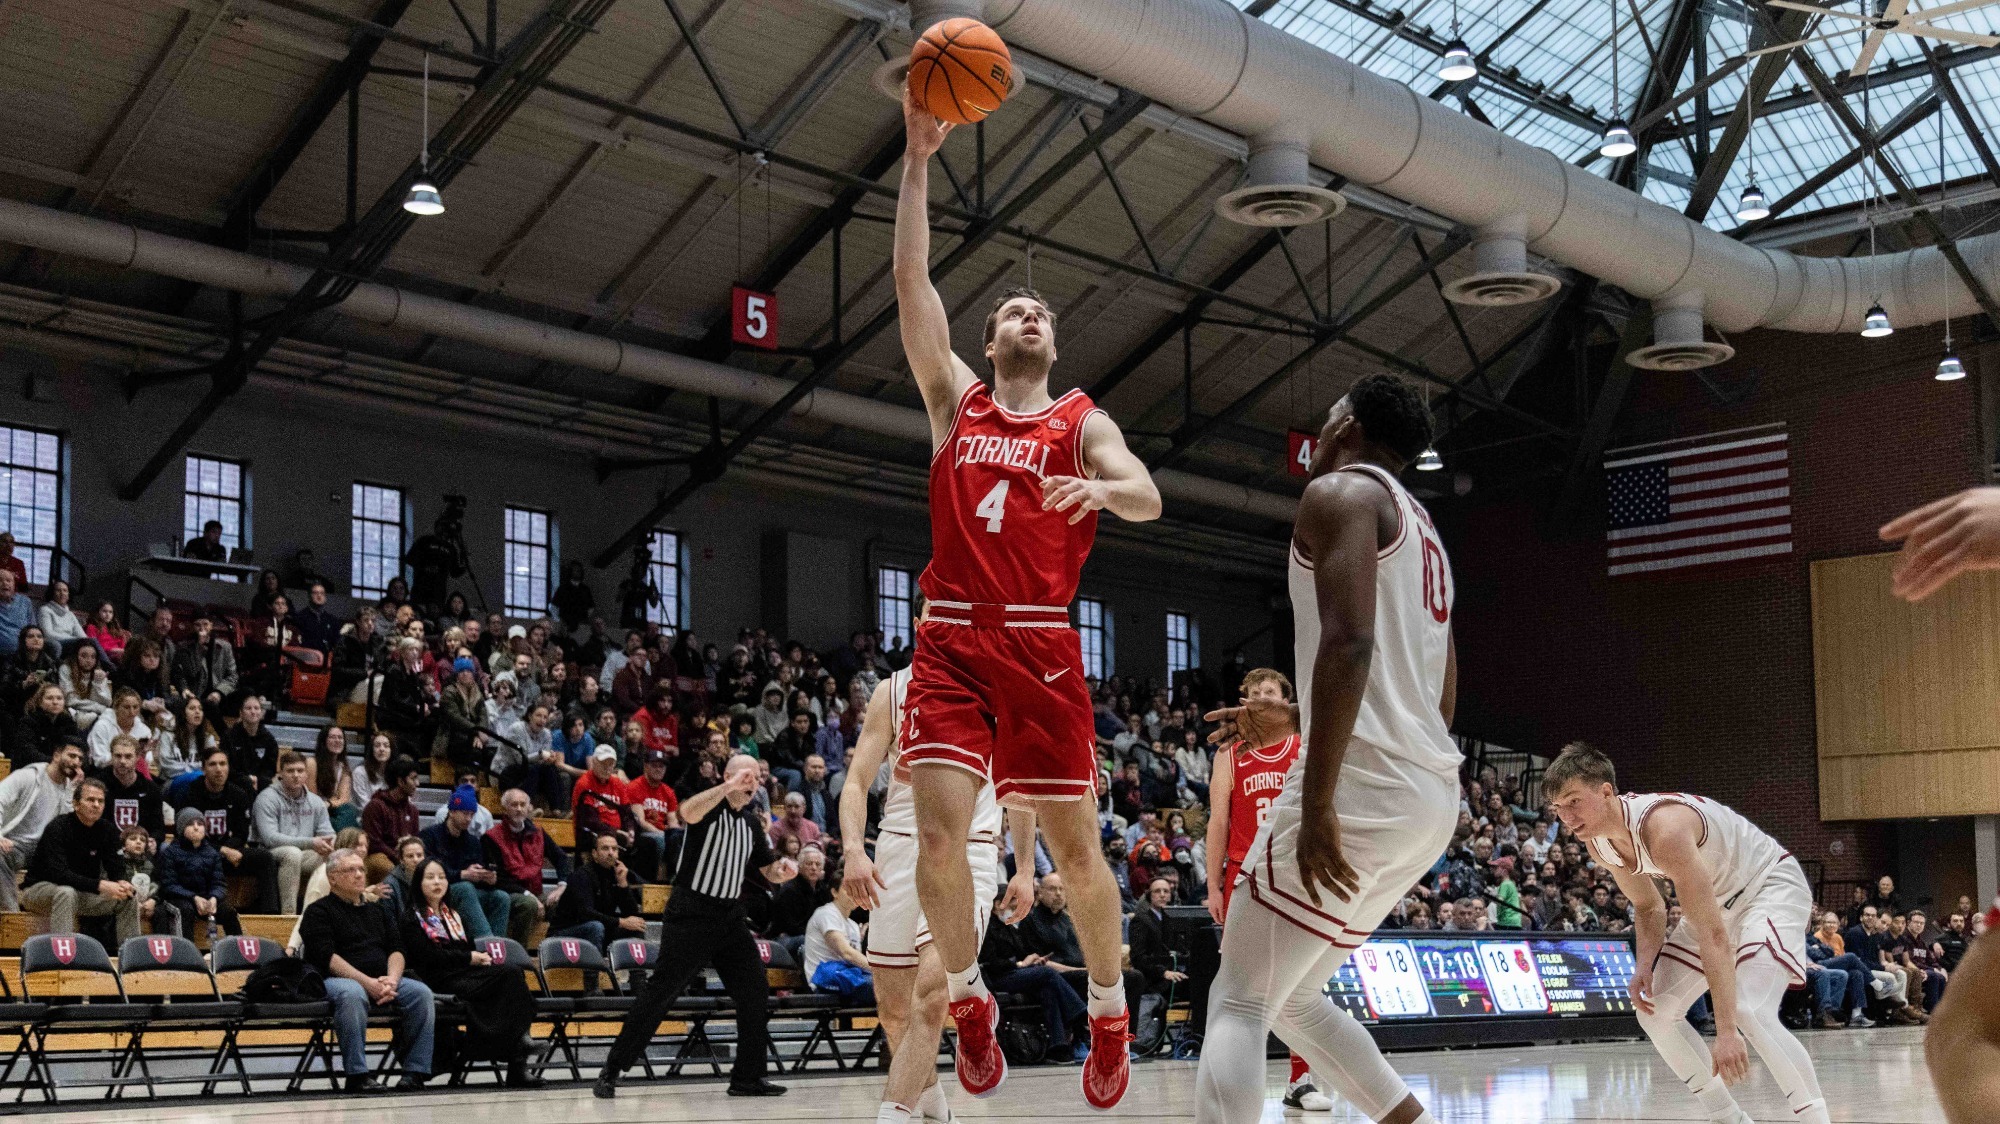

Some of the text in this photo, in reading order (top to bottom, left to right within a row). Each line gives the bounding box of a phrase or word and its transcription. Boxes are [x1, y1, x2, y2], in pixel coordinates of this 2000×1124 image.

[746, 295, 768, 339] 5
[954, 435, 1051, 482] CORNELL
[1297, 439, 1312, 472] 4
[975, 480, 1010, 533] 4
[1416, 521, 1448, 624] 10
[909, 707, 920, 740] C
[120, 808, 133, 825] H
[1256, 797, 1274, 827] 2
[209, 818, 223, 834] H
[58, 939, 71, 957] H
[154, 939, 168, 957] H
[243, 938, 256, 956] H
[489, 942, 502, 959] H
[565, 941, 577, 957] H
[631, 943, 643, 959] H
[758, 942, 770, 959] H
[1386, 949, 1408, 973] 18
[1422, 951, 1479, 980] 12:18
[1489, 950, 1509, 973] 18
